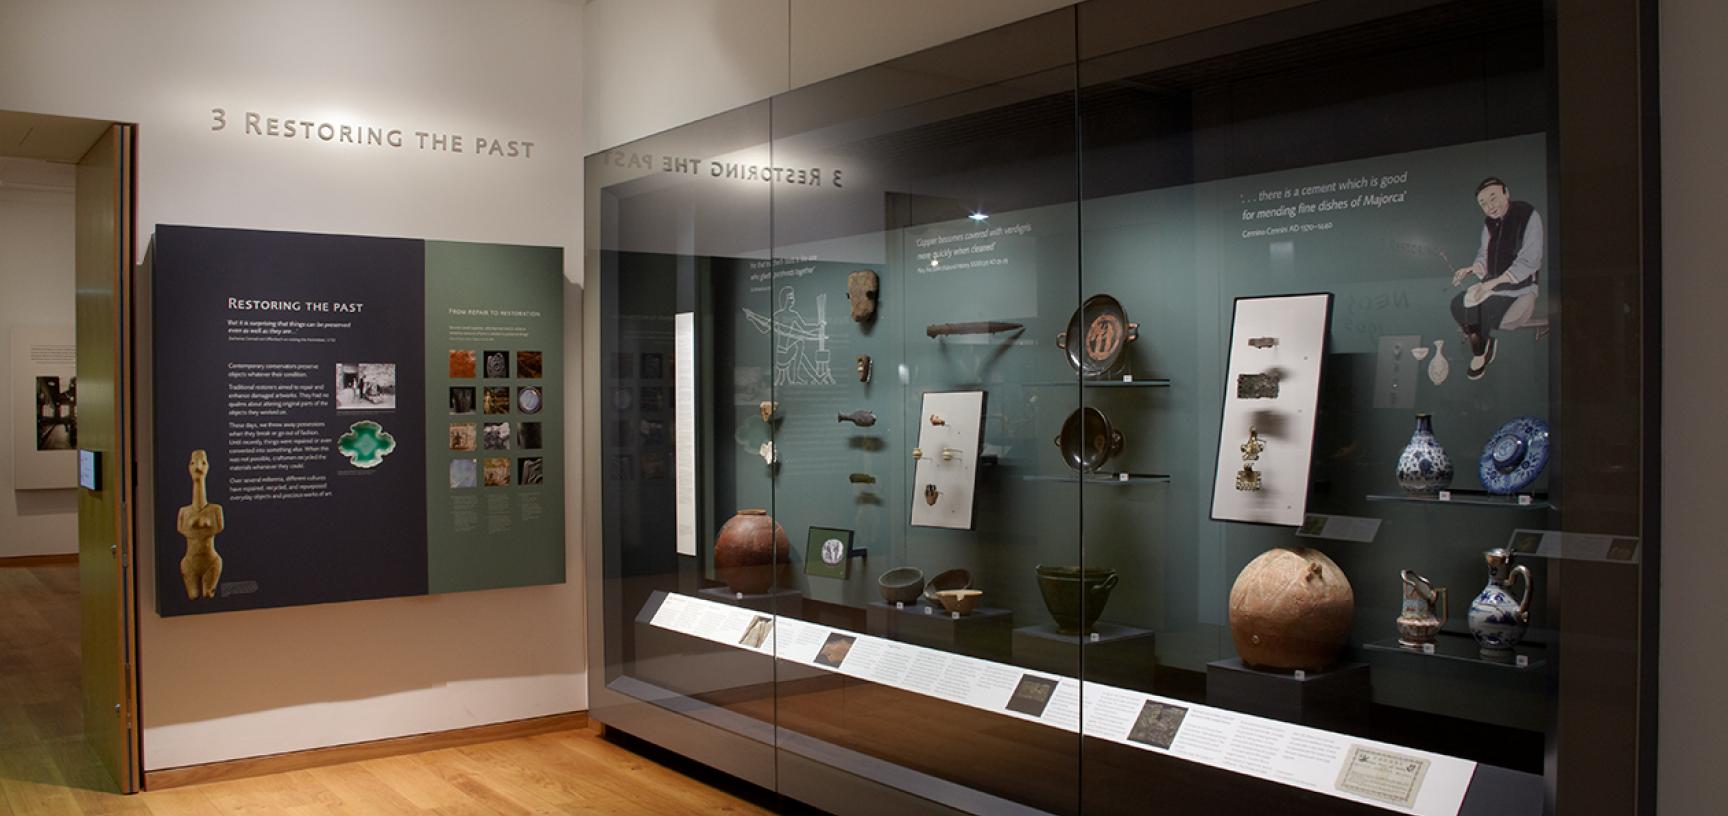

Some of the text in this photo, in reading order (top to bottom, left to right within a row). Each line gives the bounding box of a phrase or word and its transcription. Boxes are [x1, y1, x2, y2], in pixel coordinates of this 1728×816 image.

[211, 108, 226, 131] 3
[415, 131, 463, 152] THE
[475, 137, 535, 158] PAST
[1259, 190, 1282, 201] there
[1284, 188, 1291, 198] is
[1293, 189, 1299, 197] a
[1301, 183, 1336, 196] cement
[1338, 177, 1368, 191] which
[1370, 175, 1378, 187] is
[1380, 172, 1408, 188] good
[1242, 209, 1255, 221] for
[1257, 206, 1296, 219] mending
[1298, 203, 1316, 214] fine
[1318, 199, 1348, 211] dishes
[1351, 195, 1362, 207] of
[305, 302, 329, 312] THE
[333, 303, 363, 313] PAST
